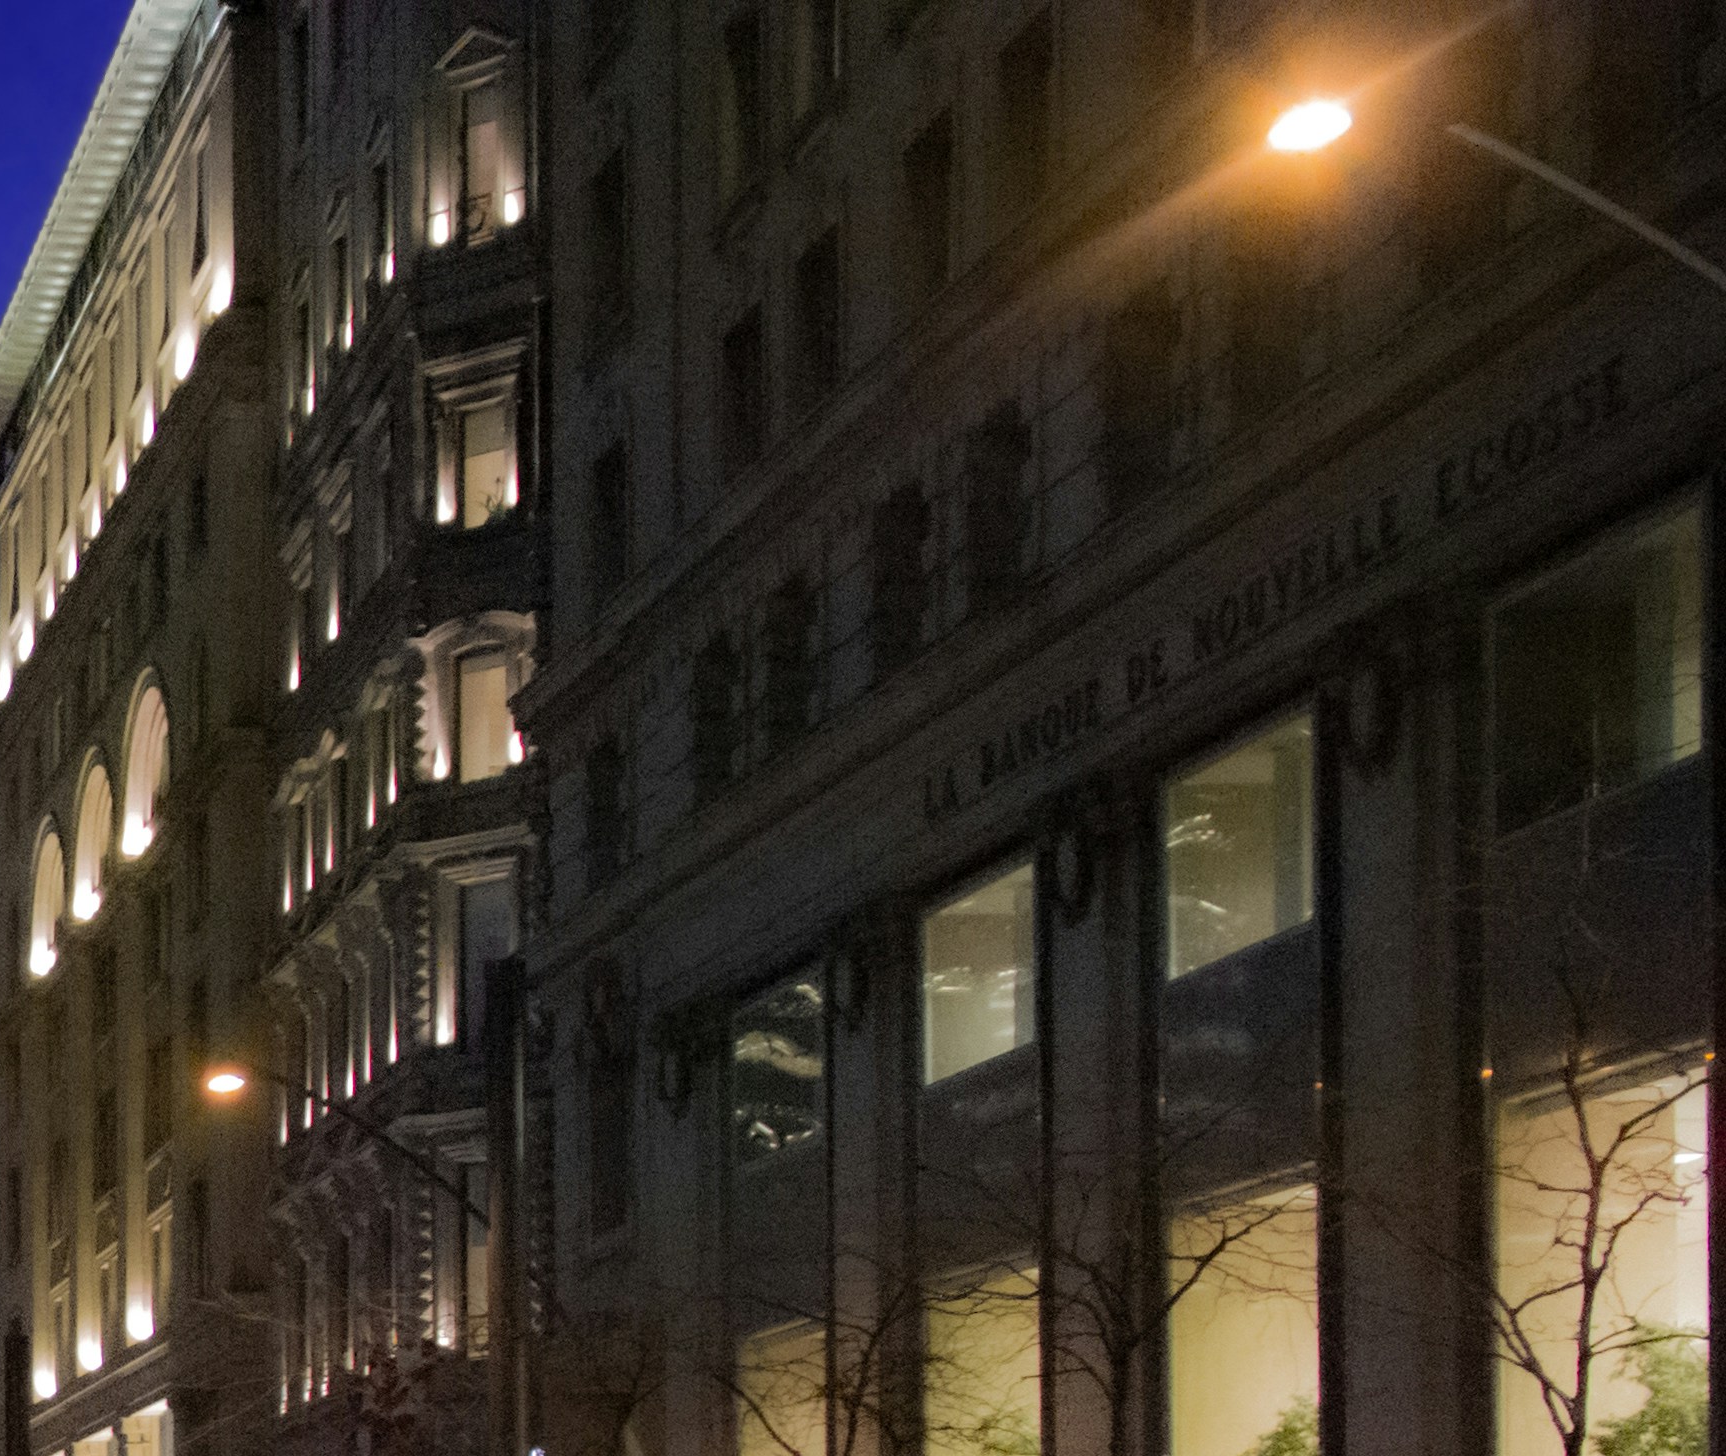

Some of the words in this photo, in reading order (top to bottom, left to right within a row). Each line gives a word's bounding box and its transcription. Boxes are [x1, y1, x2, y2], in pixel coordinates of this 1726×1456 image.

[979, 680, 1102, 786] BANQUE
[1126, 645, 1170, 705] DE
[1191, 494, 1404, 662] NOUVELLE
